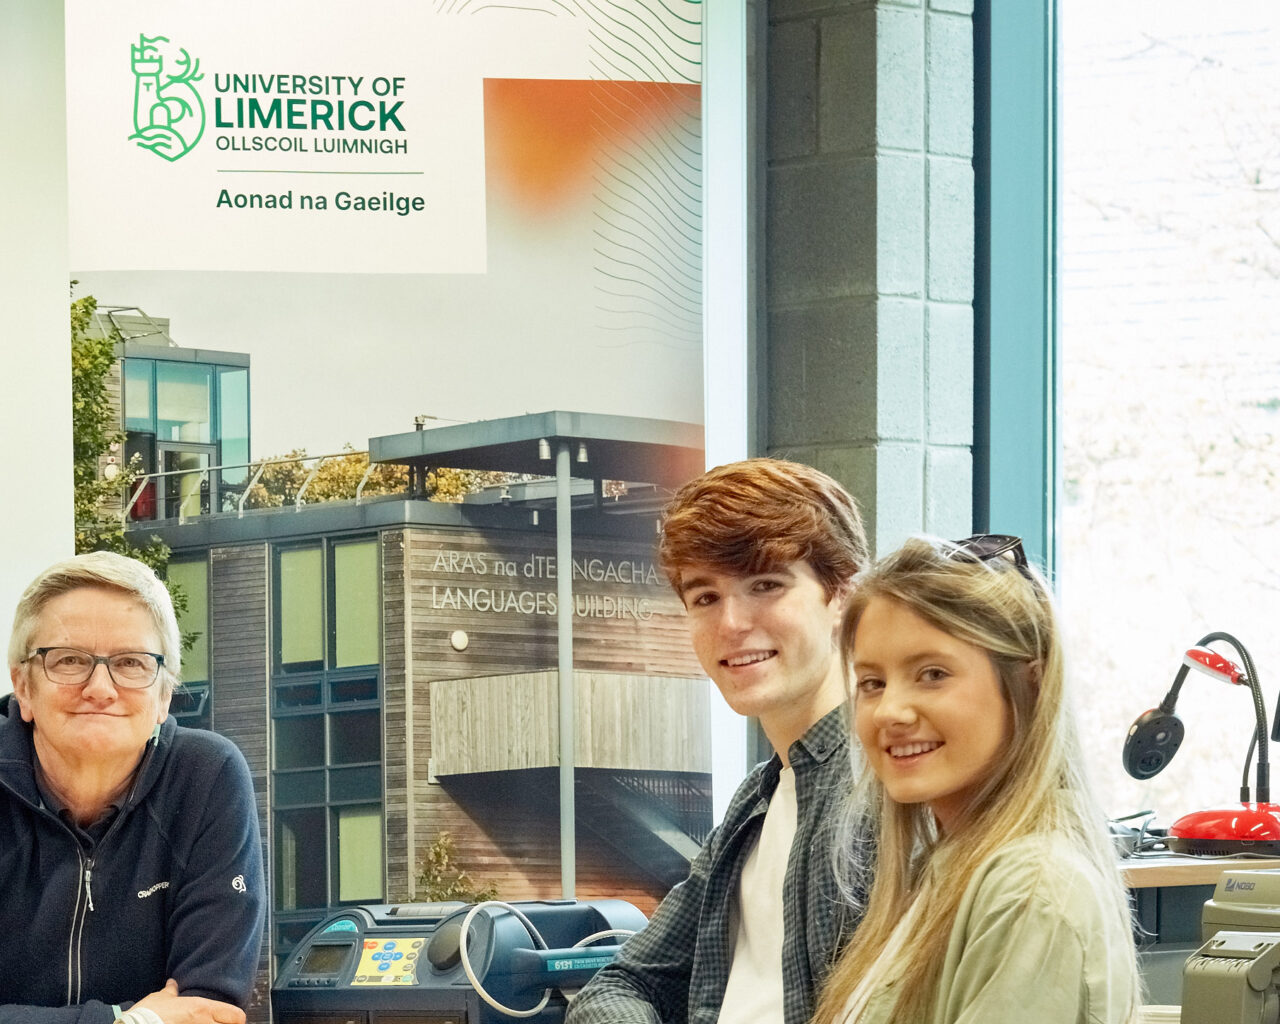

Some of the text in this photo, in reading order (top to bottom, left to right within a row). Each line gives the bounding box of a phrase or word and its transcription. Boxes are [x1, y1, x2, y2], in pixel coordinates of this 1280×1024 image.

[214, 73, 406, 97] UNIVERSITY OF
[214, 97, 407, 132] LIMERICK
[215, 135, 408, 154] OLLSCOIL LUIMNIGH
[216, 188, 426, 216] Aonad na Gaeilge
[431, 543, 660, 585] ÁRAS na dTENGACHA
[431, 586, 558, 616] LANGUAGES
